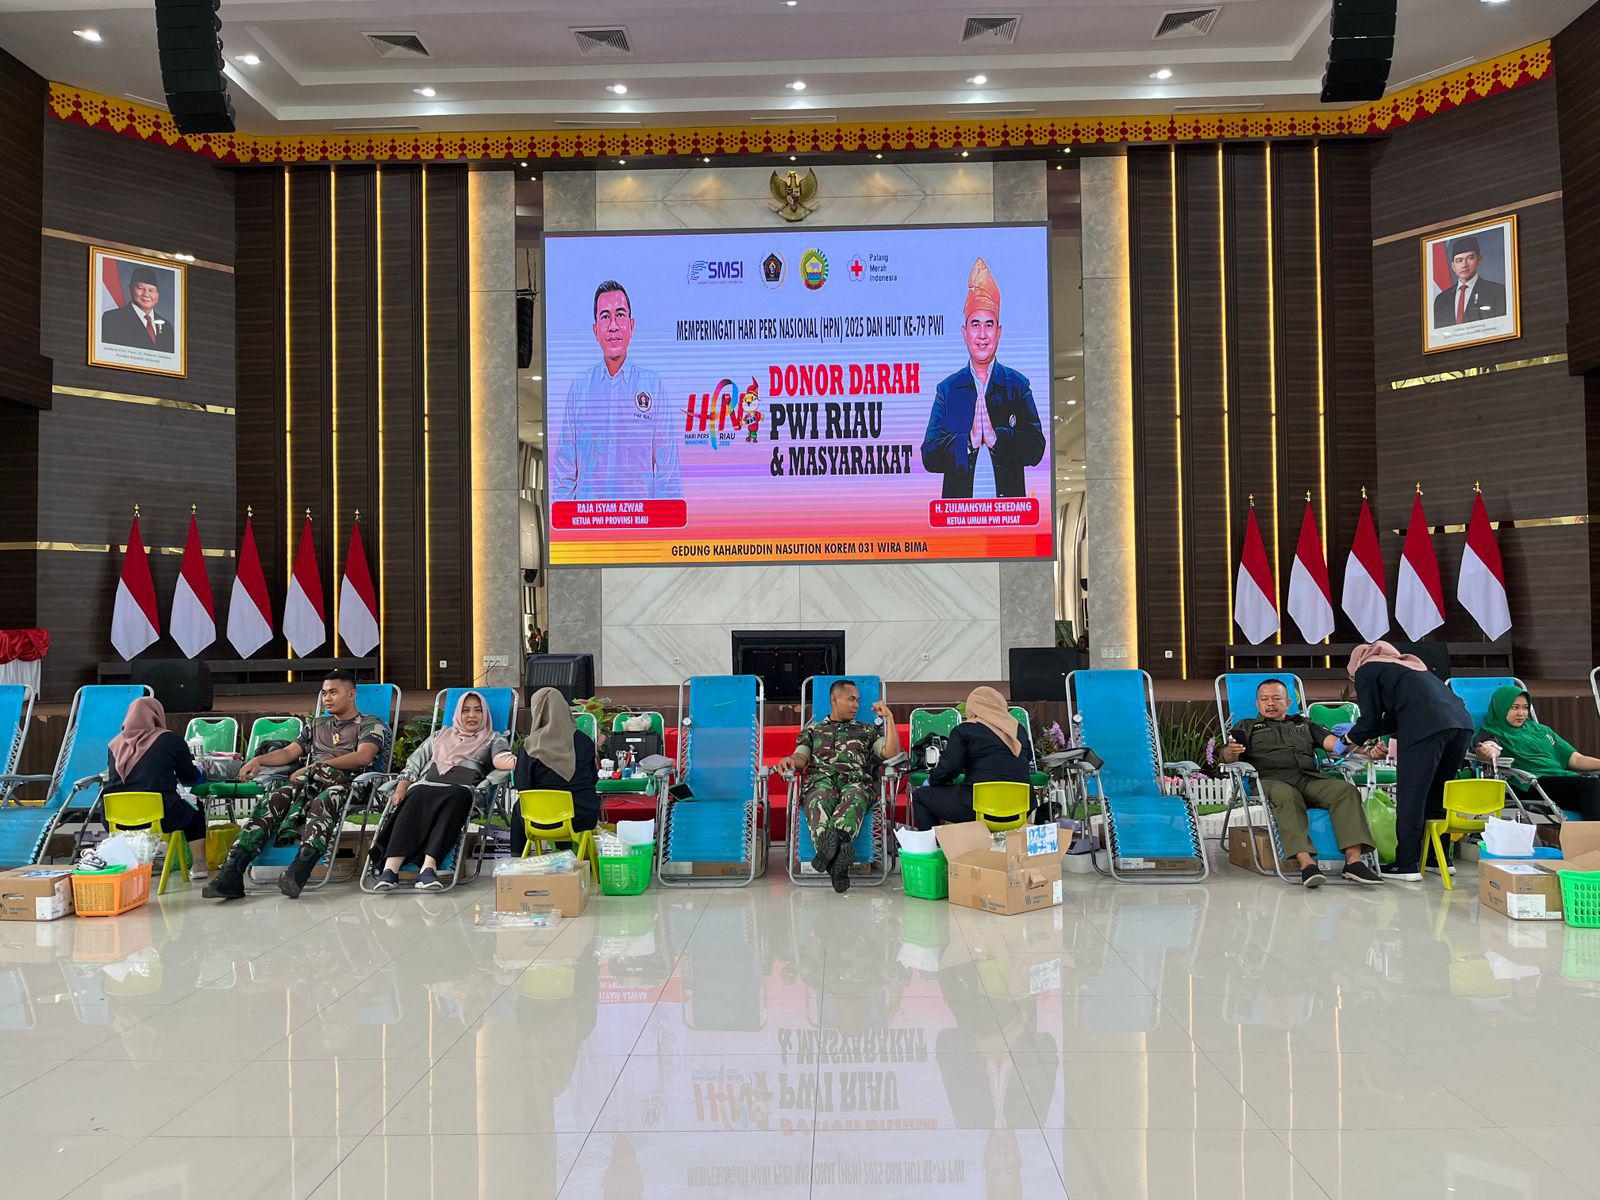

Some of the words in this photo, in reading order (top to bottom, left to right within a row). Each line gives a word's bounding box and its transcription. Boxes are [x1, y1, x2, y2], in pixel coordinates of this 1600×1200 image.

[869, 253, 888, 262] Palang
[708, 261, 743, 279] SMSI
[869, 264, 887, 272] Merah
[869, 274, 898, 282] Indonesia
[676, 320, 735, 340] MEMPERINGATI
[738, 319, 757, 339] HARI
[759, 318, 777, 339] PERS
[779, 317, 818, 339] NASIONAL
[820, 316, 842, 343] (HPN)
[845, 317, 864, 337] 2025
[866, 316, 883, 337] DAN
[885, 316, 901, 337] HUT
[904, 315, 926, 336] KE-79
[928, 315, 944, 335] PWI
[769, 364, 844, 396] DONOR
[849, 363, 920, 395] DARAH
[770, 403, 819, 440] PWI
[825, 402, 883, 439] RIAU
[719, 432, 736, 440] RIAU
[770, 446, 784, 477] &
[789, 445, 913, 476] MASYARAKAT
[577, 503, 594, 513] RAJA
[595, 503, 617, 513] ISYAM
[618, 502, 644, 513] AZWAR
[935, 503, 943, 513] H.
[945, 502, 993, 513] ZULMANSYAH
[994, 501, 1032, 512] SEKEDANG
[572, 516, 591, 525] KETUA
[592, 516, 604, 525] PWI
[605, 516, 633, 525] PROVINSI
[946, 516, 966, 525] KETUA
[988, 515, 1001, 524] PWI
[1001, 515, 1021, 524] PUSAT
[671, 545, 711, 556] GEDUNG
[713, 544, 773, 556] KAHARUDDIN
[775, 543, 822, 555] NASUTION
[824, 542, 856, 554] KOREM
[858, 542, 874, 553] 031
[877, 542, 902, 553] WIRA
[904, 541, 928, 553] BIMA
